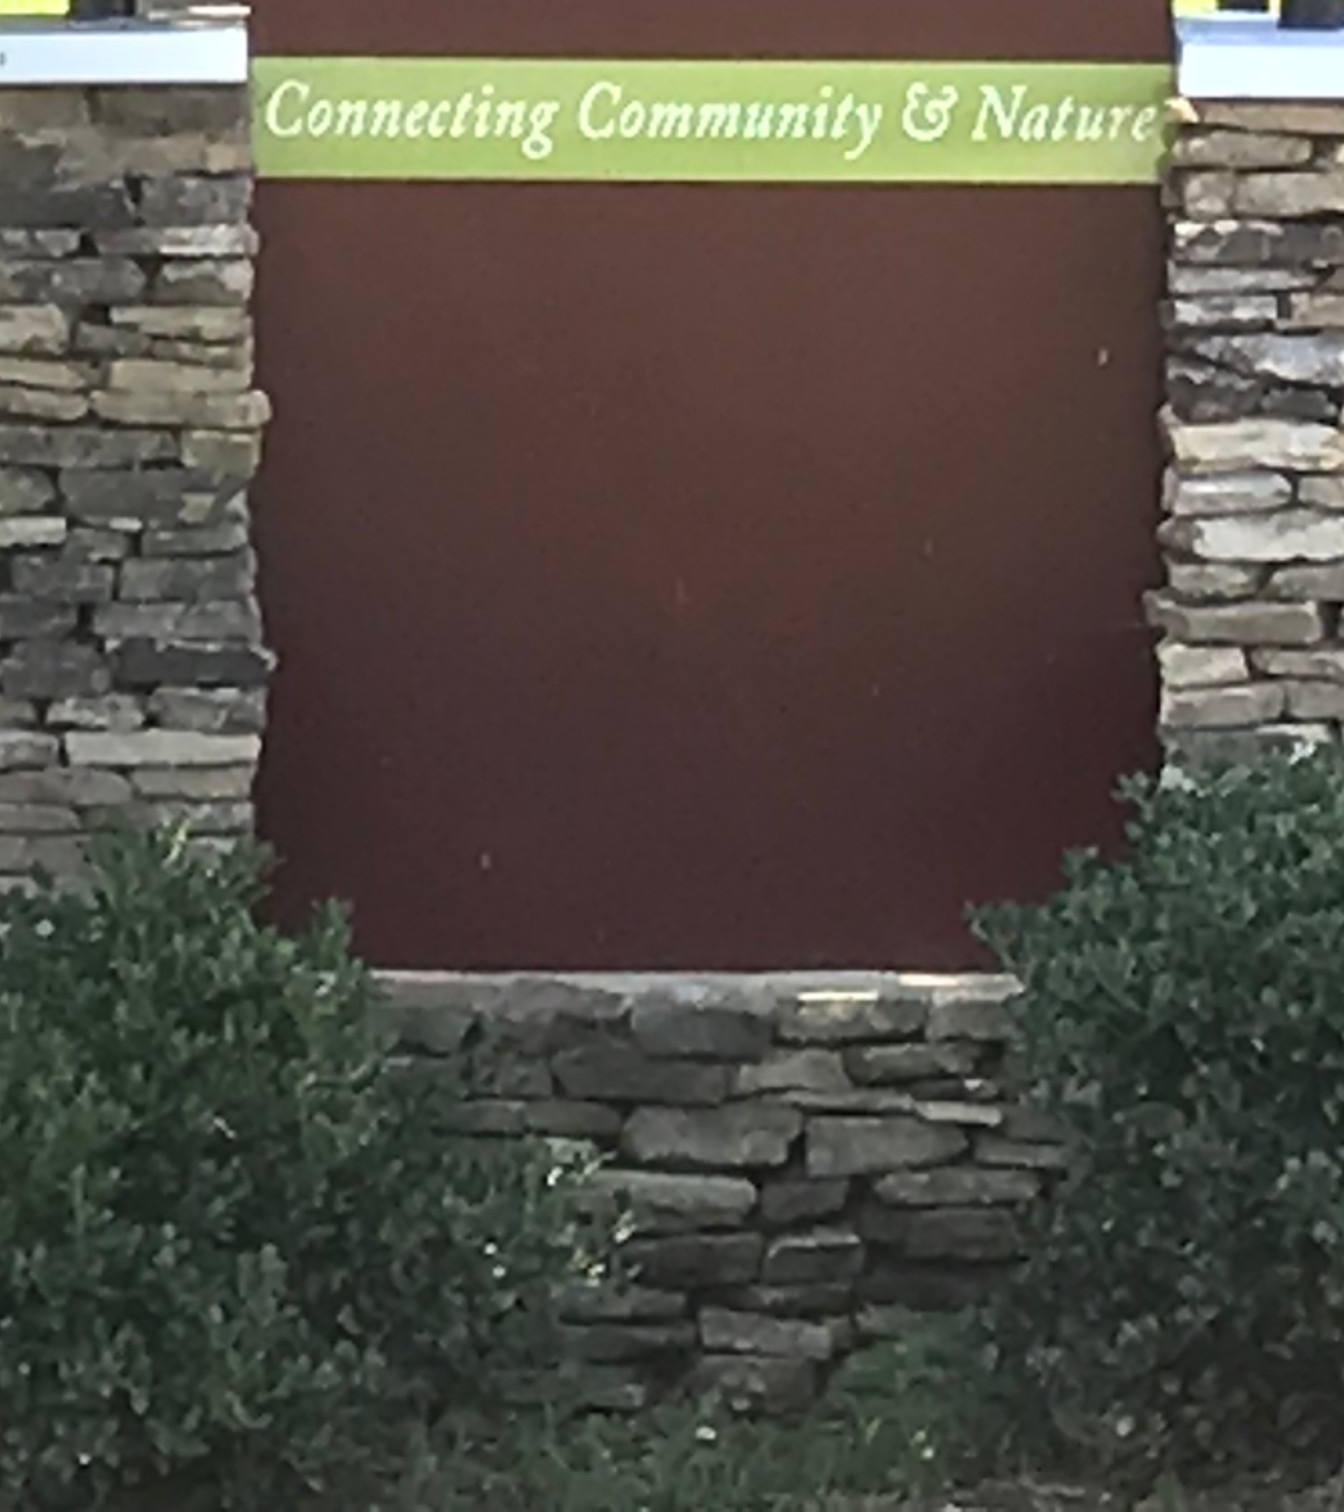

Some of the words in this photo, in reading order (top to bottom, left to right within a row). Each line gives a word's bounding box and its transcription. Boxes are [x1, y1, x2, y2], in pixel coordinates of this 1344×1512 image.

[264, 78, 560, 160] Connecting
[576, 79, 883, 161] Community
[901, 81, 959, 142] &
[971, 84, 1157, 143] Nature
